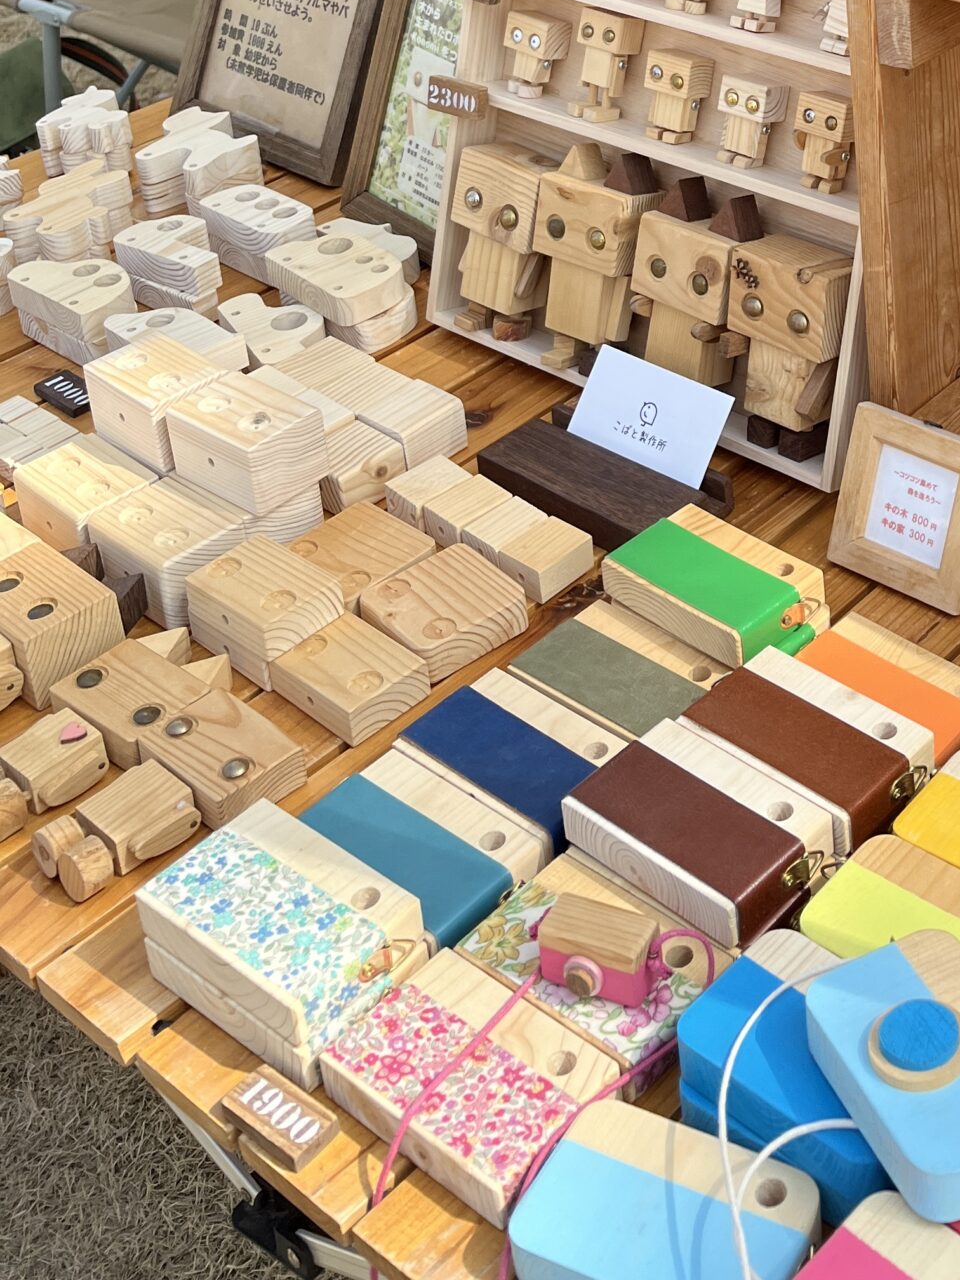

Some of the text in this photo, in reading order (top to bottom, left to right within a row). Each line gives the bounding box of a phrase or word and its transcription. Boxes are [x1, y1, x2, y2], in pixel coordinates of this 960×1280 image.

[429, 84, 476, 113] 2300
[44, 375, 90, 406] 1000
[613, 420, 667, 452] こばと製作所
[239, 1078, 320, 1144] 1900
